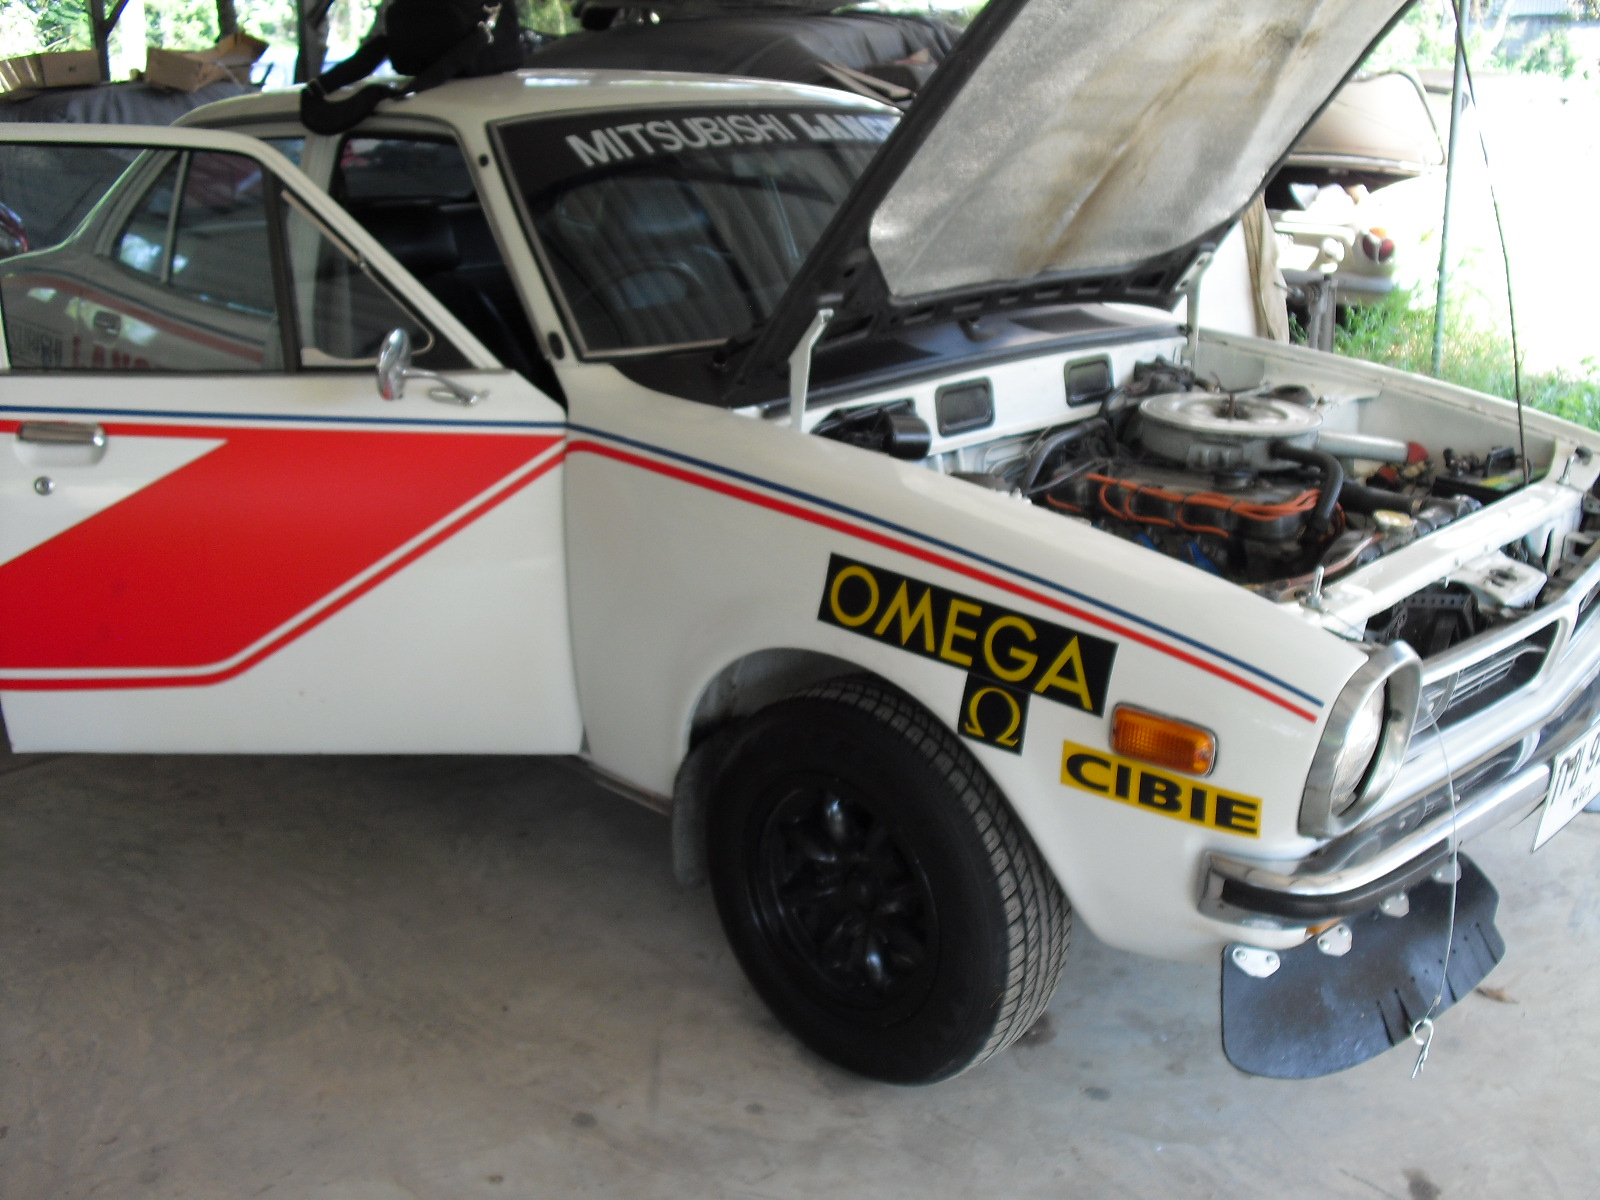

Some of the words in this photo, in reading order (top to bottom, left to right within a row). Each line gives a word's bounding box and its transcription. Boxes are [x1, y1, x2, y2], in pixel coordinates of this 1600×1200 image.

[565, 113, 799, 167] MITSUBISHI
[791, 112, 902, 143] LANC
[829, 565, 1094, 711] OMEGA
[1066, 752, 1258, 835] CIBIE
